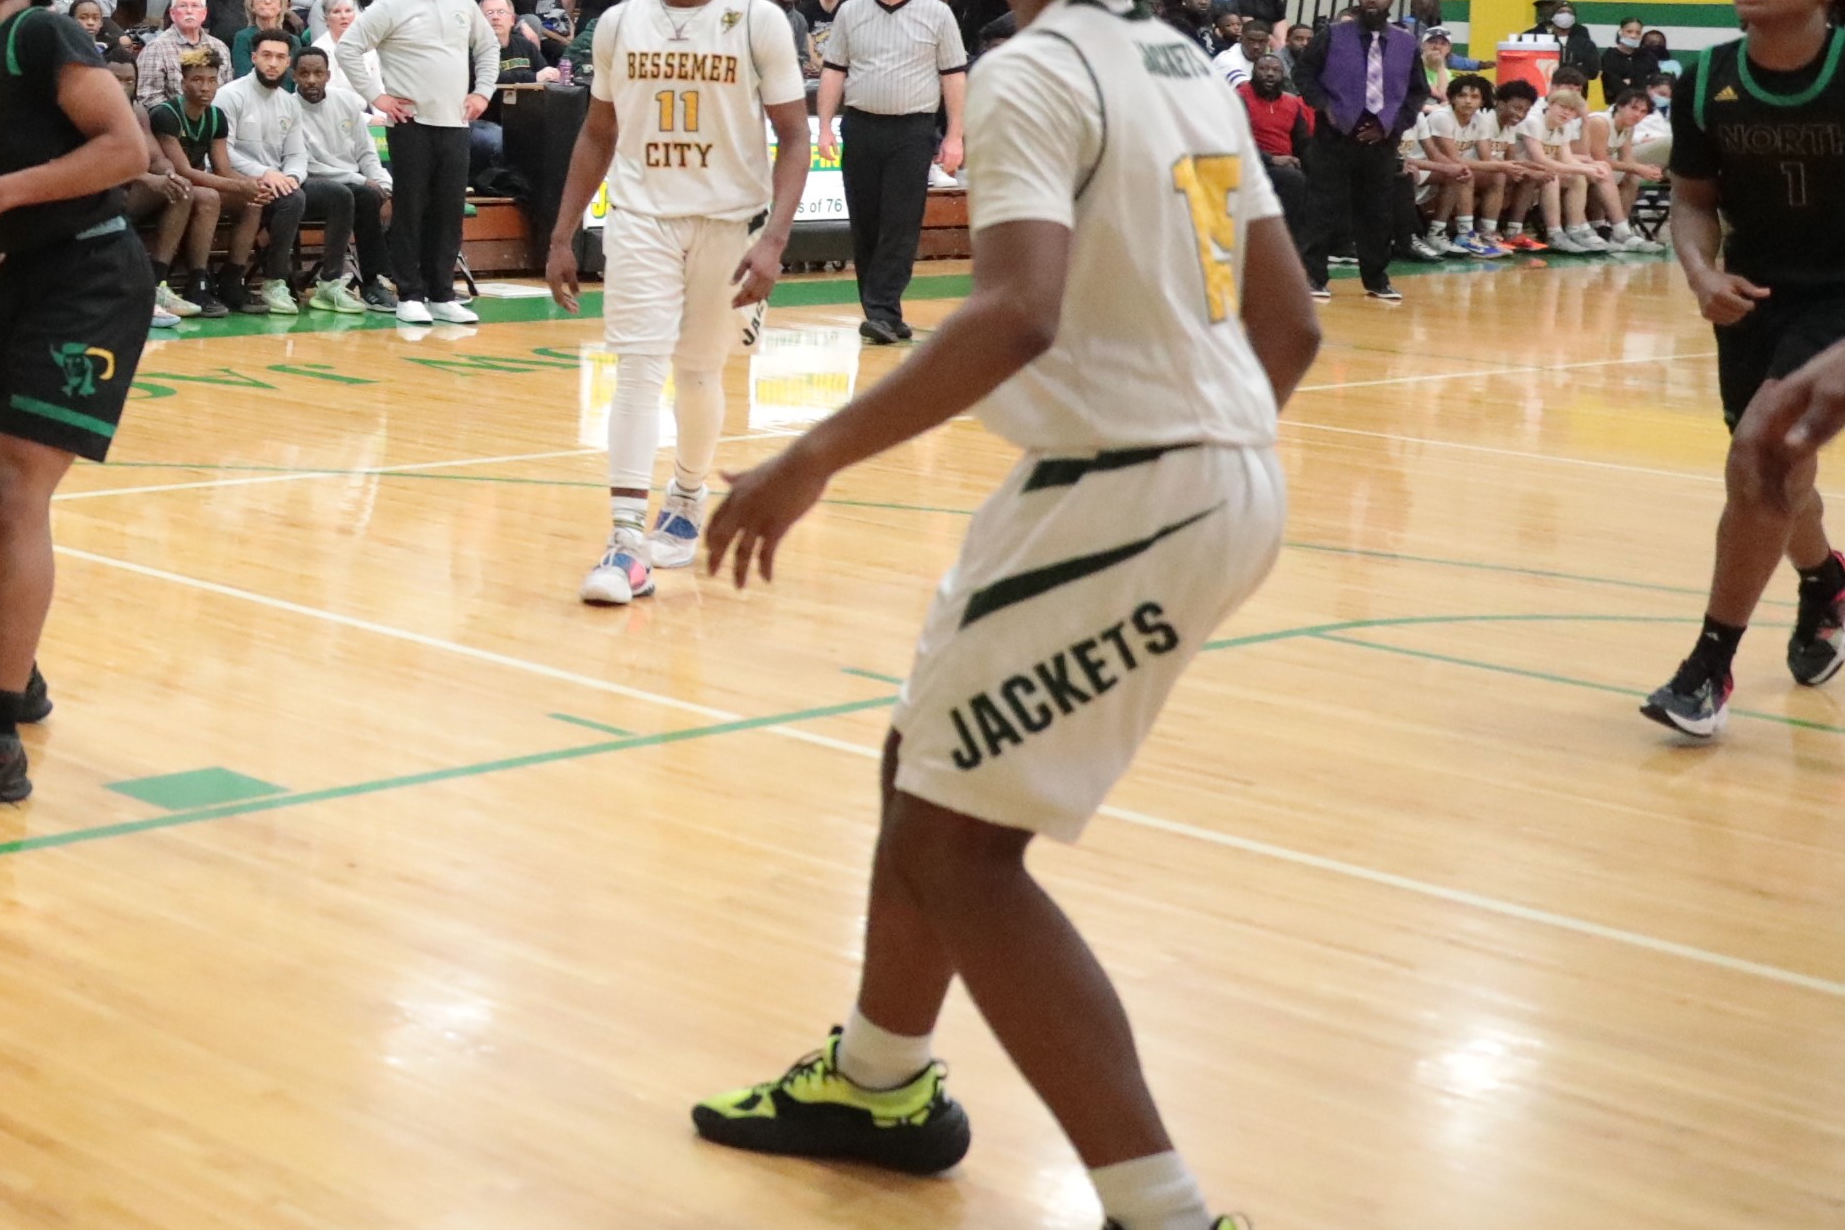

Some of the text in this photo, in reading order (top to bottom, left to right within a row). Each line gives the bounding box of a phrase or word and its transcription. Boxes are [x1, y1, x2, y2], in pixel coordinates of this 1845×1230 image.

[627, 52, 738, 84] BESSEMER
[654, 90, 699, 132] 11
[645, 142, 713, 168] CITY
[1780, 161, 1806, 207] 1
[809, 198, 823, 214] of
[826, 198, 843, 213] 76
[949, 601, 1182, 772] JACKETS
